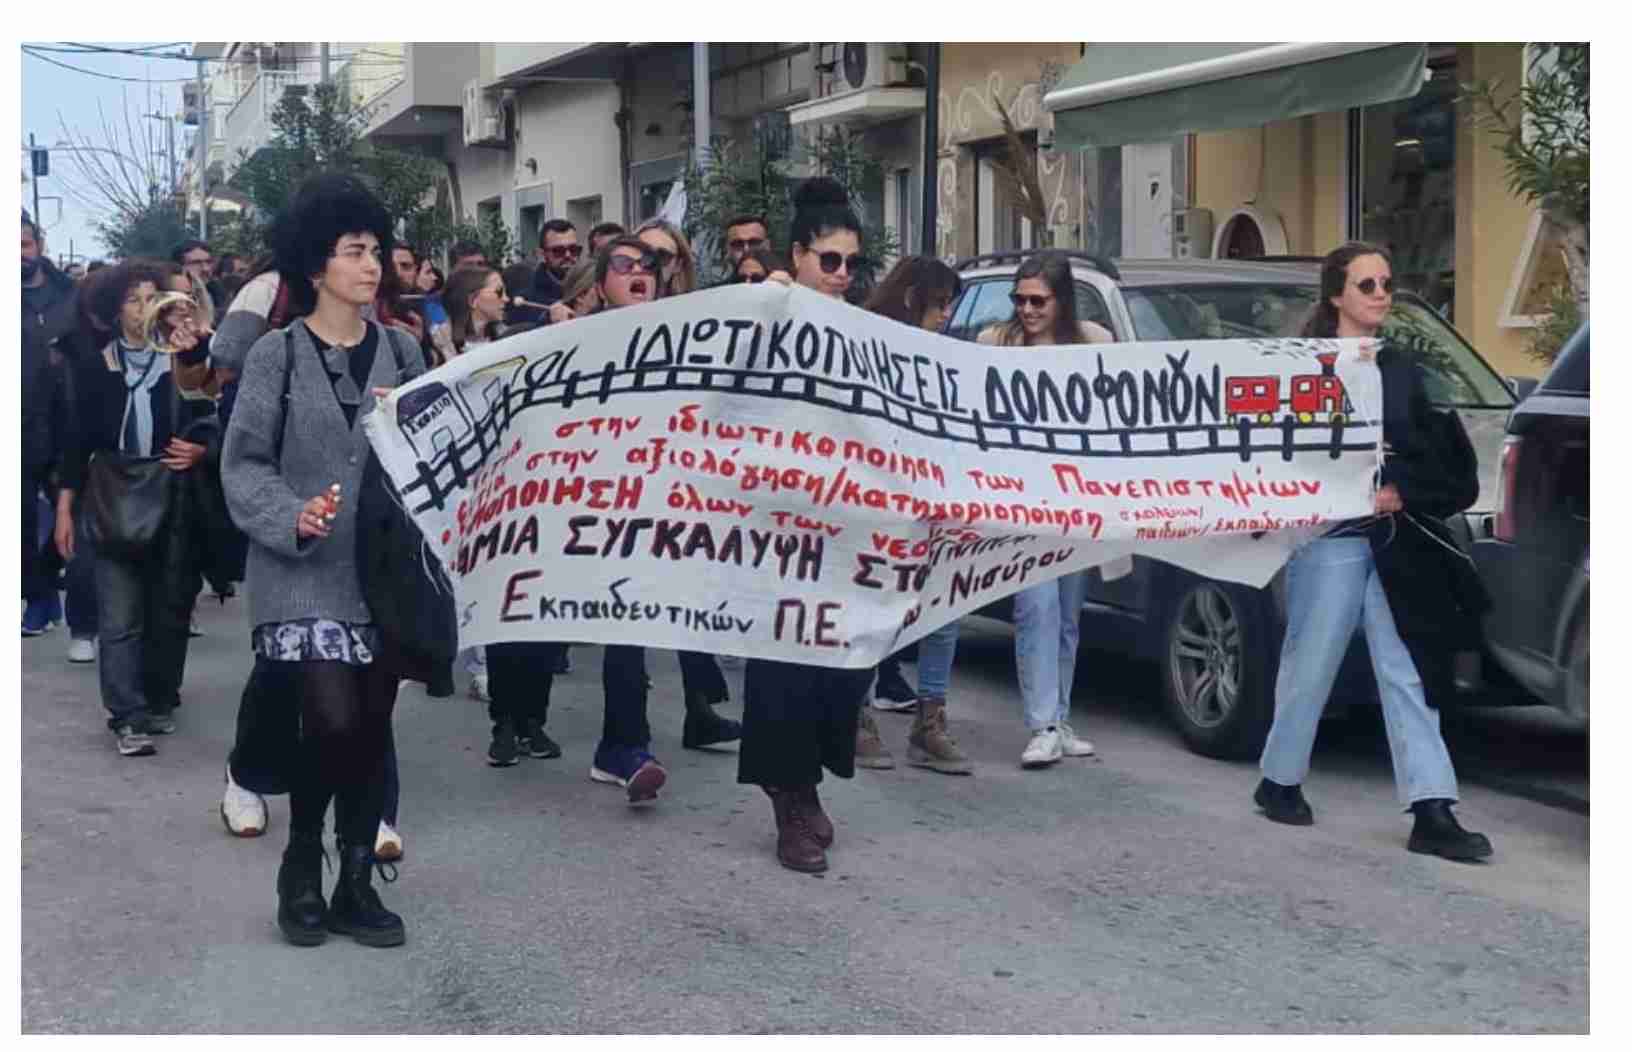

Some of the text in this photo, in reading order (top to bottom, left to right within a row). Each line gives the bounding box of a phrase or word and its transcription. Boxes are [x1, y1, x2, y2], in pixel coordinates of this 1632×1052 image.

[525, 449, 599, 473] στην
[555, 415, 642, 440] στην
[967, 468, 1025, 491] των
[667, 481, 754, 517] όλων
[770, 511, 844, 537] των
[564, 516, 824, 582] ΣΥΓΚΑΛΥΨΗ
